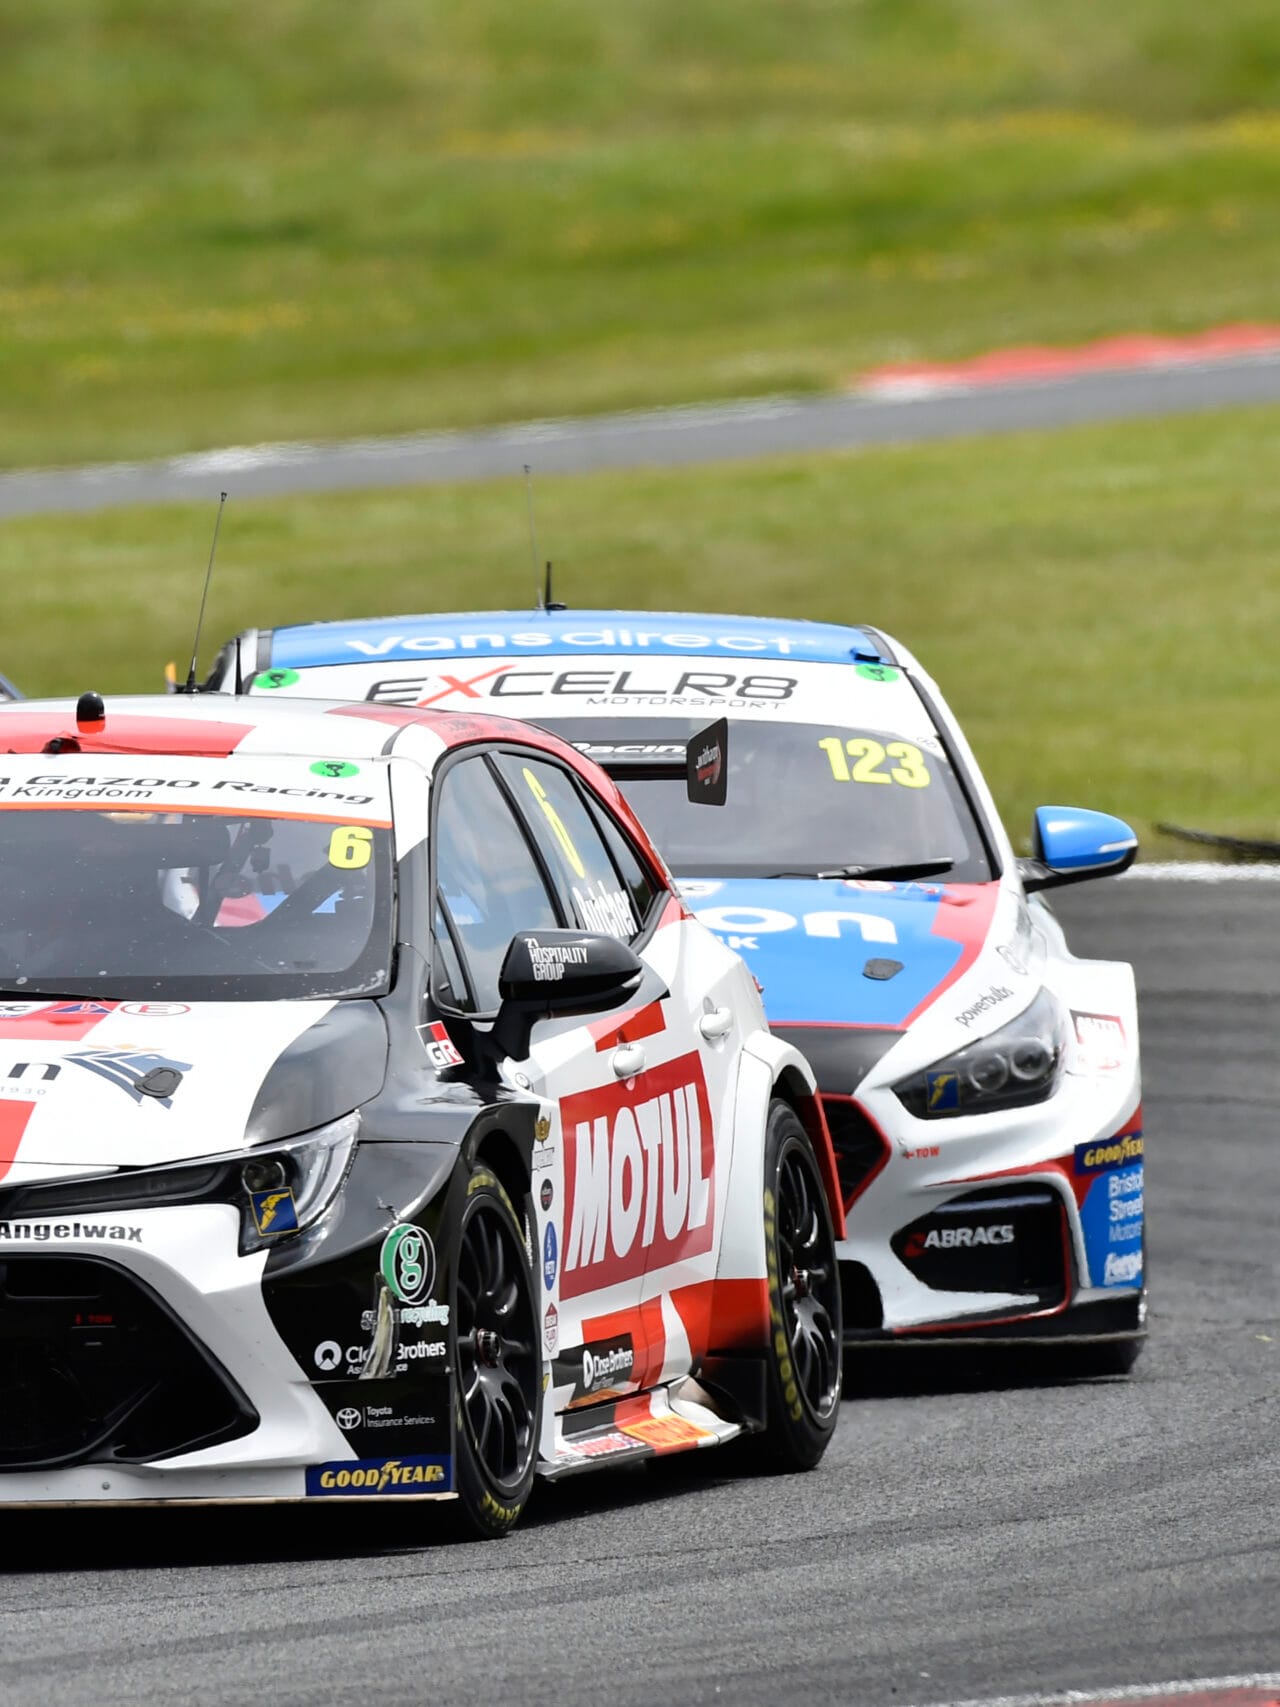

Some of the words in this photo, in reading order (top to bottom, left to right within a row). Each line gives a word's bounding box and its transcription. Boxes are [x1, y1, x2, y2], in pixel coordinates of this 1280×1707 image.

[345, 629, 796, 656] vansdirect
[366, 665, 799, 706] EXCELR8
[585, 697, 786, 710] MOTORSPORT
[818, 737, 931, 788] 123
[11, 786, 154, 800] Kingdom
[26, 775, 201, 789] GAZOO
[211, 780, 375, 805] Racing
[327, 825, 374, 869] 6
[524, 938, 539, 949] 21
[529, 947, 588, 964] HOSPITALITY
[533, 963, 565, 981] GROUP
[955, 985, 1015, 1028] powerbulbs
[426, 1038, 463, 1067] GR
[0, 1085, 48, 1096] 1930
[916, 1146, 939, 1158] TOW
[565, 1082, 710, 1272] MOTUL
[924, 1225, 1015, 1248] ABRACS
[399, 1236, 422, 1290] g
[366, 1406, 393, 1417] Toyota
[367, 1417, 403, 1428] Insurance
[404, 1415, 436, 1426] Services
